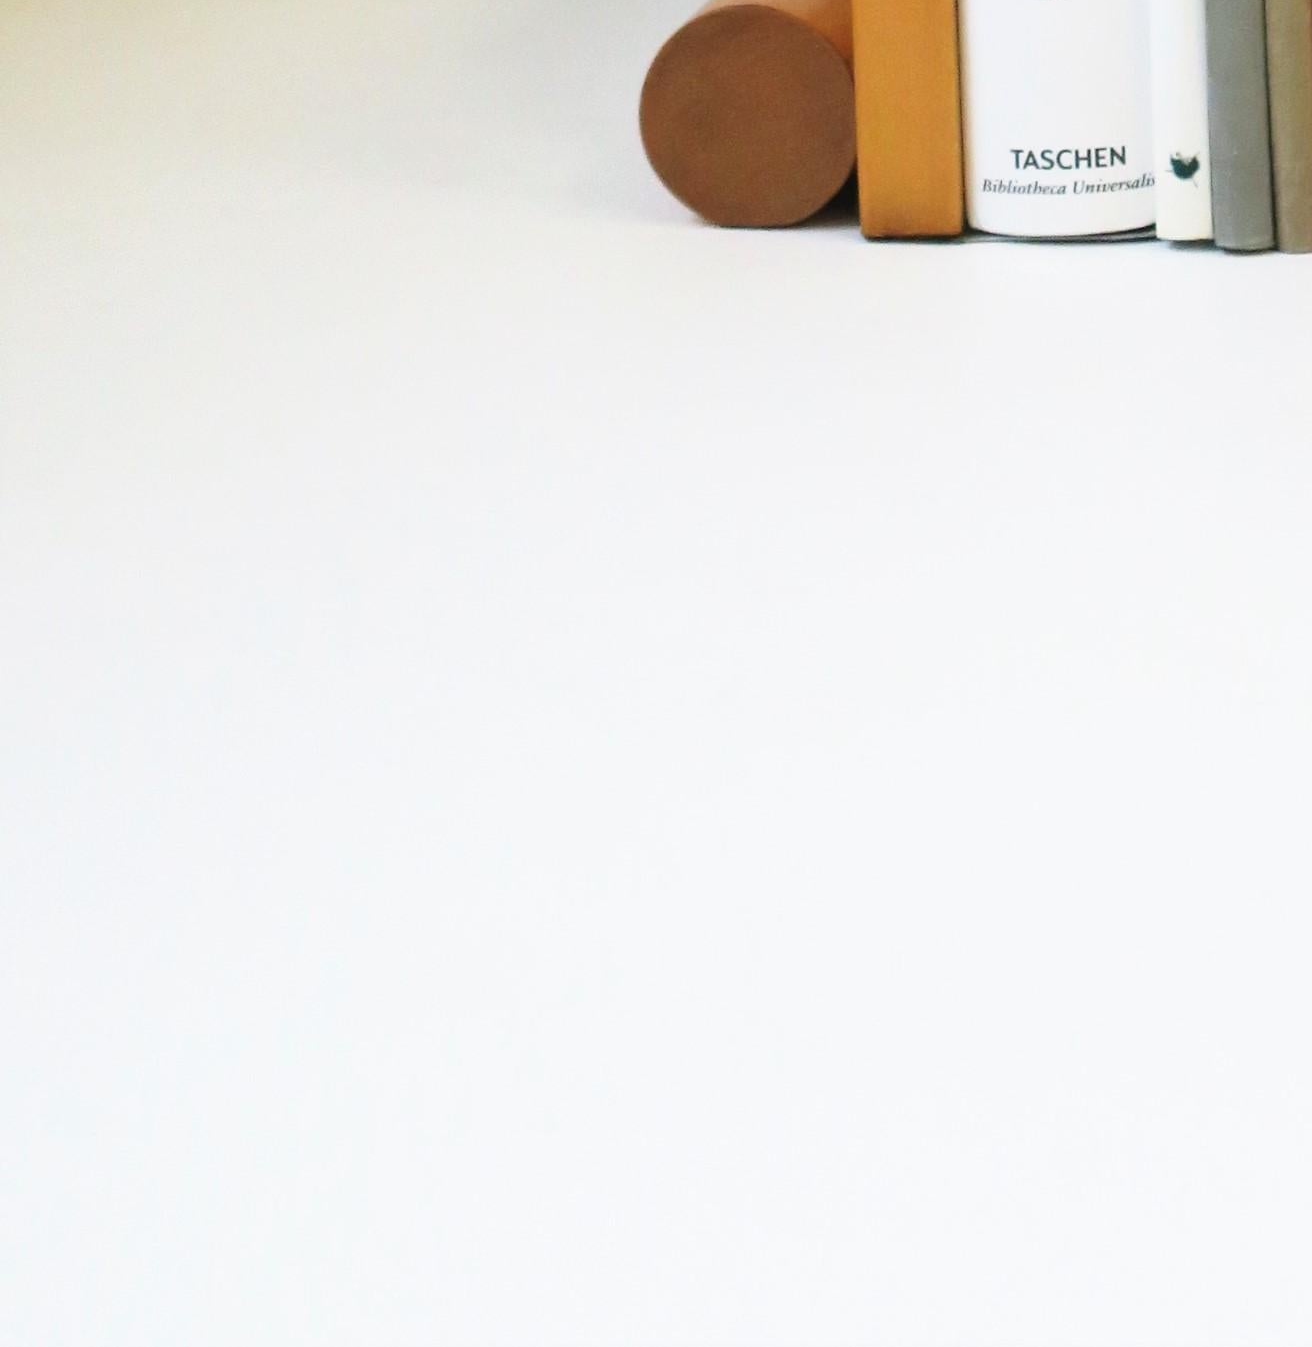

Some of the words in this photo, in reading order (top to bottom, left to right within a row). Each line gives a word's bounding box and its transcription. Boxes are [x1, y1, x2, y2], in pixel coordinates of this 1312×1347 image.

[1010, 145, 1127, 171] TASCHEN
[982, 179, 1067, 195] Bibliotheca
[1073, 173, 1156, 194] Universalis
